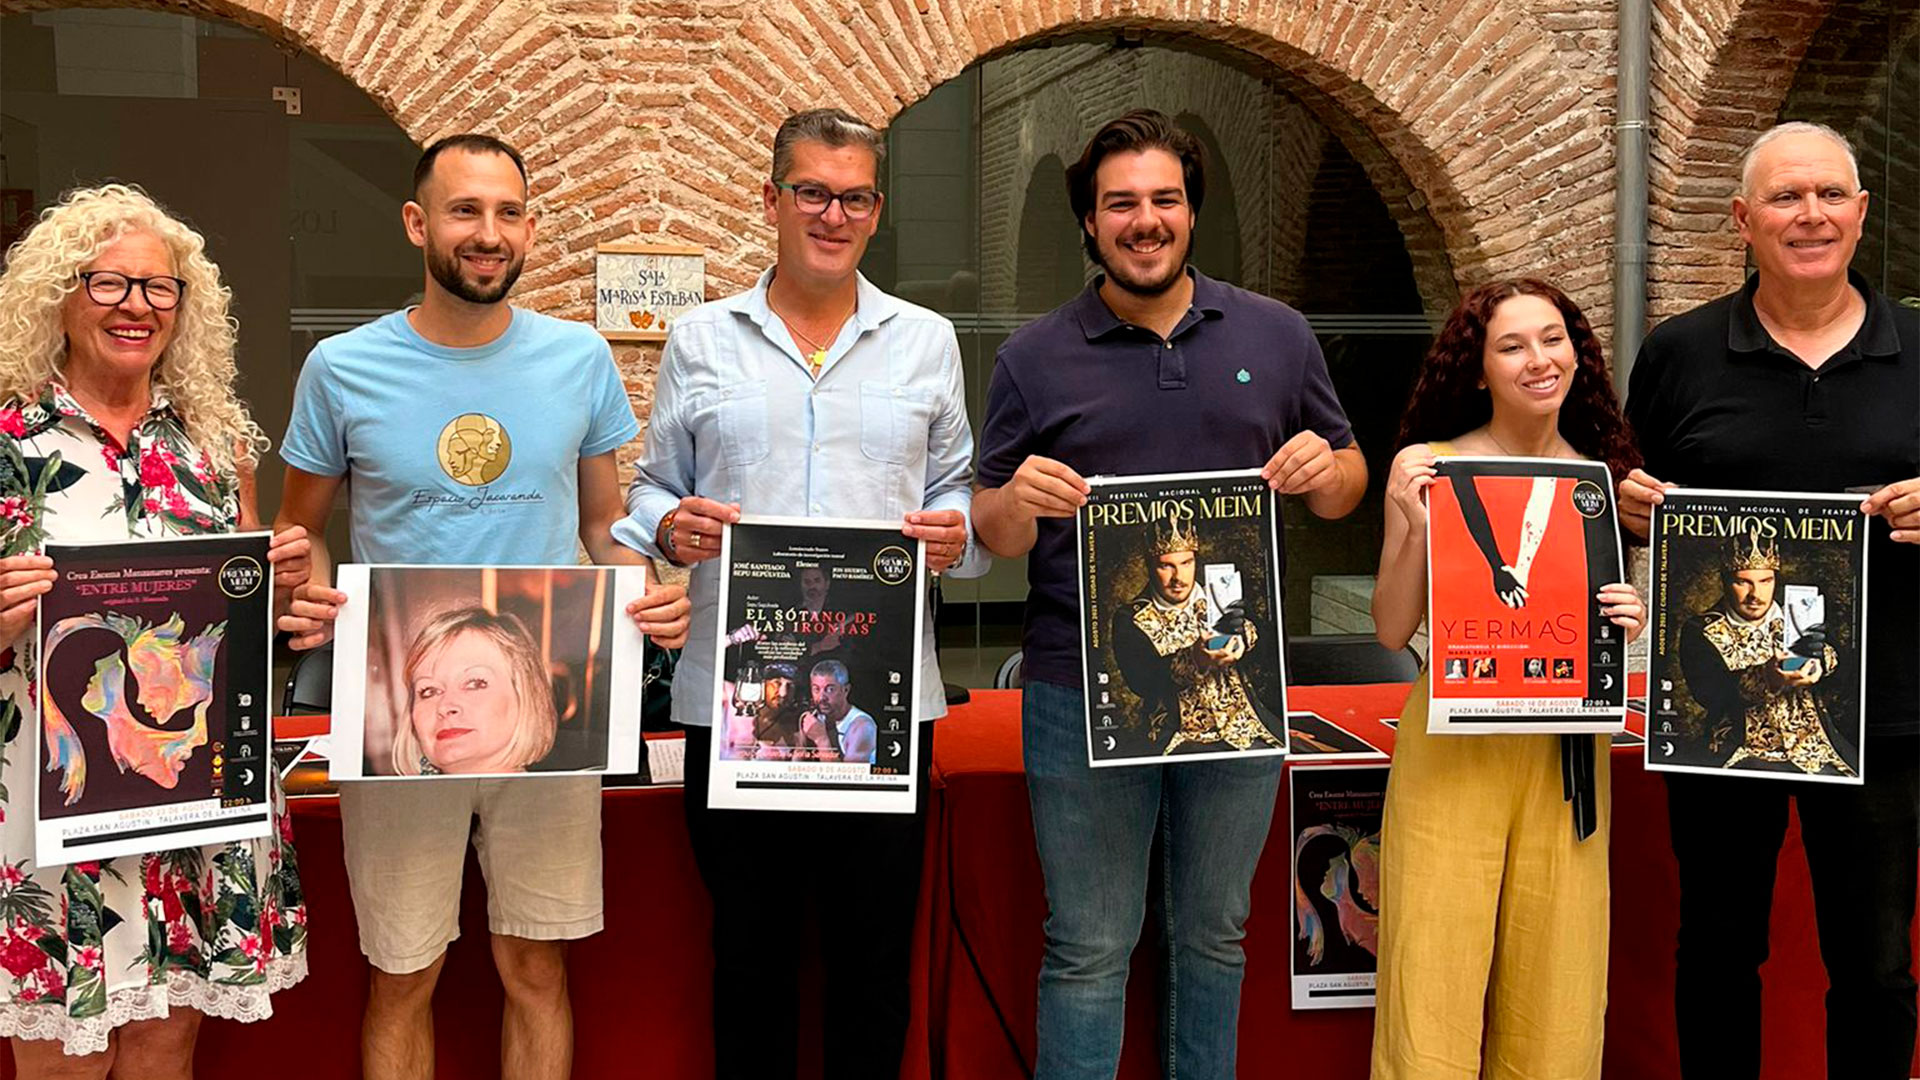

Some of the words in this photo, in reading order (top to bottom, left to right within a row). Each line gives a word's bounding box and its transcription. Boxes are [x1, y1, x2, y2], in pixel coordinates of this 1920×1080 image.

[638, 269, 666, 287] SALA
[600, 288, 647, 306] MARISA
[650, 289, 702, 307] ESTEBAN
[1109, 492, 1148, 500] FESTIVAL
[1159, 489, 1200, 497] NACIONAL
[1211, 487, 1222, 495] DE
[1232, 484, 1265, 493] TEATRO
[1088, 498, 1195, 527] PREMIOS
[1200, 495, 1262, 520] MEIM
[1686, 504, 1728, 512] FESTIVAL
[1740, 506, 1786, 515] NACIONAL
[1798, 507, 1810, 515] DE
[1822, 508, 1858, 516] TEATRO
[1662, 513, 1778, 539] PREMIOS
[1784, 517, 1854, 542] MEIM
[750, 563, 786, 571] SANTIAGO
[746, 608, 767, 620] EL
[774, 606, 846, 622] SÓTANO
[855, 612, 877, 624] DE
[753, 620, 784, 633] LAS
[1441, 613, 1578, 645] YERMAS
[1529, 706, 1564, 714] TALAVERA
[1566, 706, 1575, 714] DE
[816, 773, 851, 781] TALAVERA
[837, 766, 867, 774] AGOSTO
[182, 802, 216, 813] AGOSTO
[62, 825, 91, 837] PLAZA
[93, 823, 111, 833] SAN
[159, 812, 200, 824] TALAVERA
